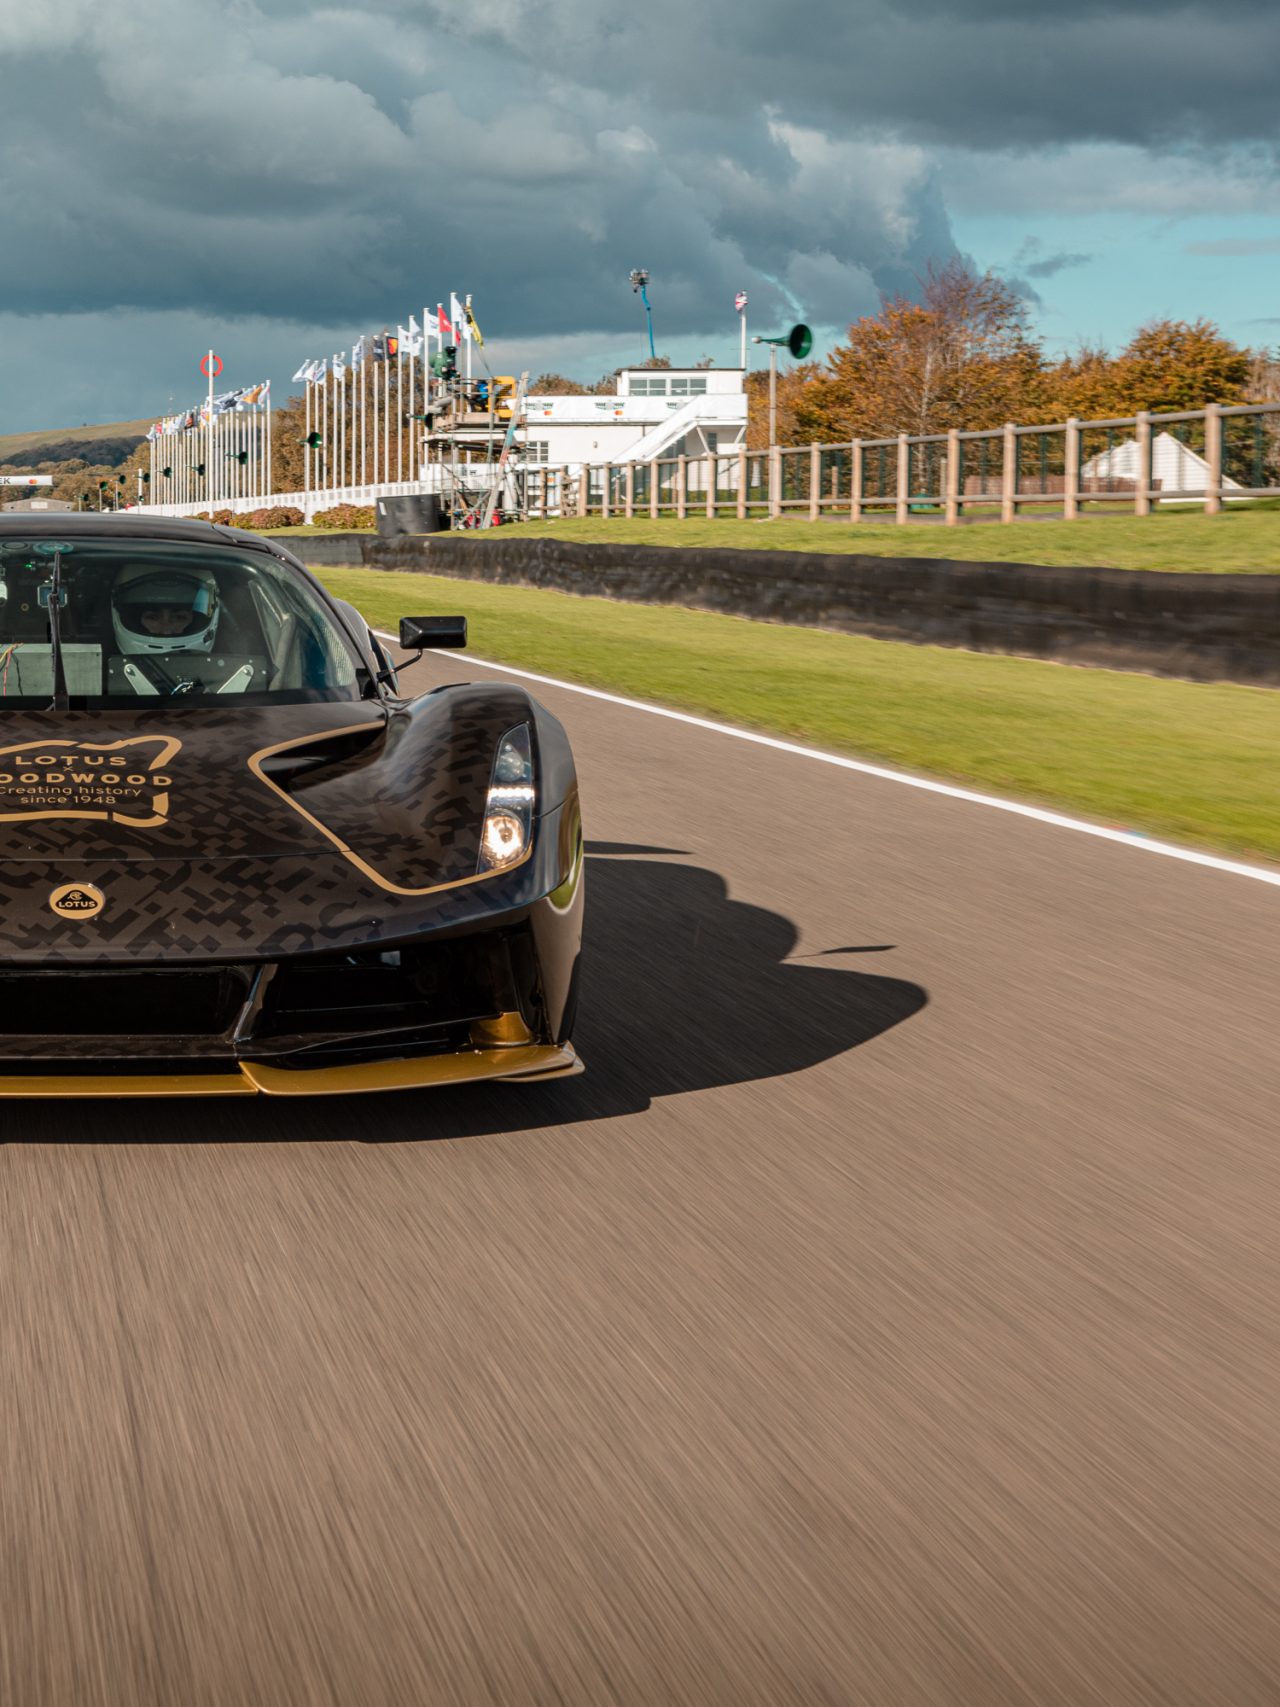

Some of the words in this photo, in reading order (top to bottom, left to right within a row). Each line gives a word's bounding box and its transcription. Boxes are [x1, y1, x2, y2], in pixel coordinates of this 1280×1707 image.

[15, 755, 127, 766] LOTUS
[79, 786, 142, 797] history
[20, 795, 68, 804] since
[74, 795, 116, 804] 1948
